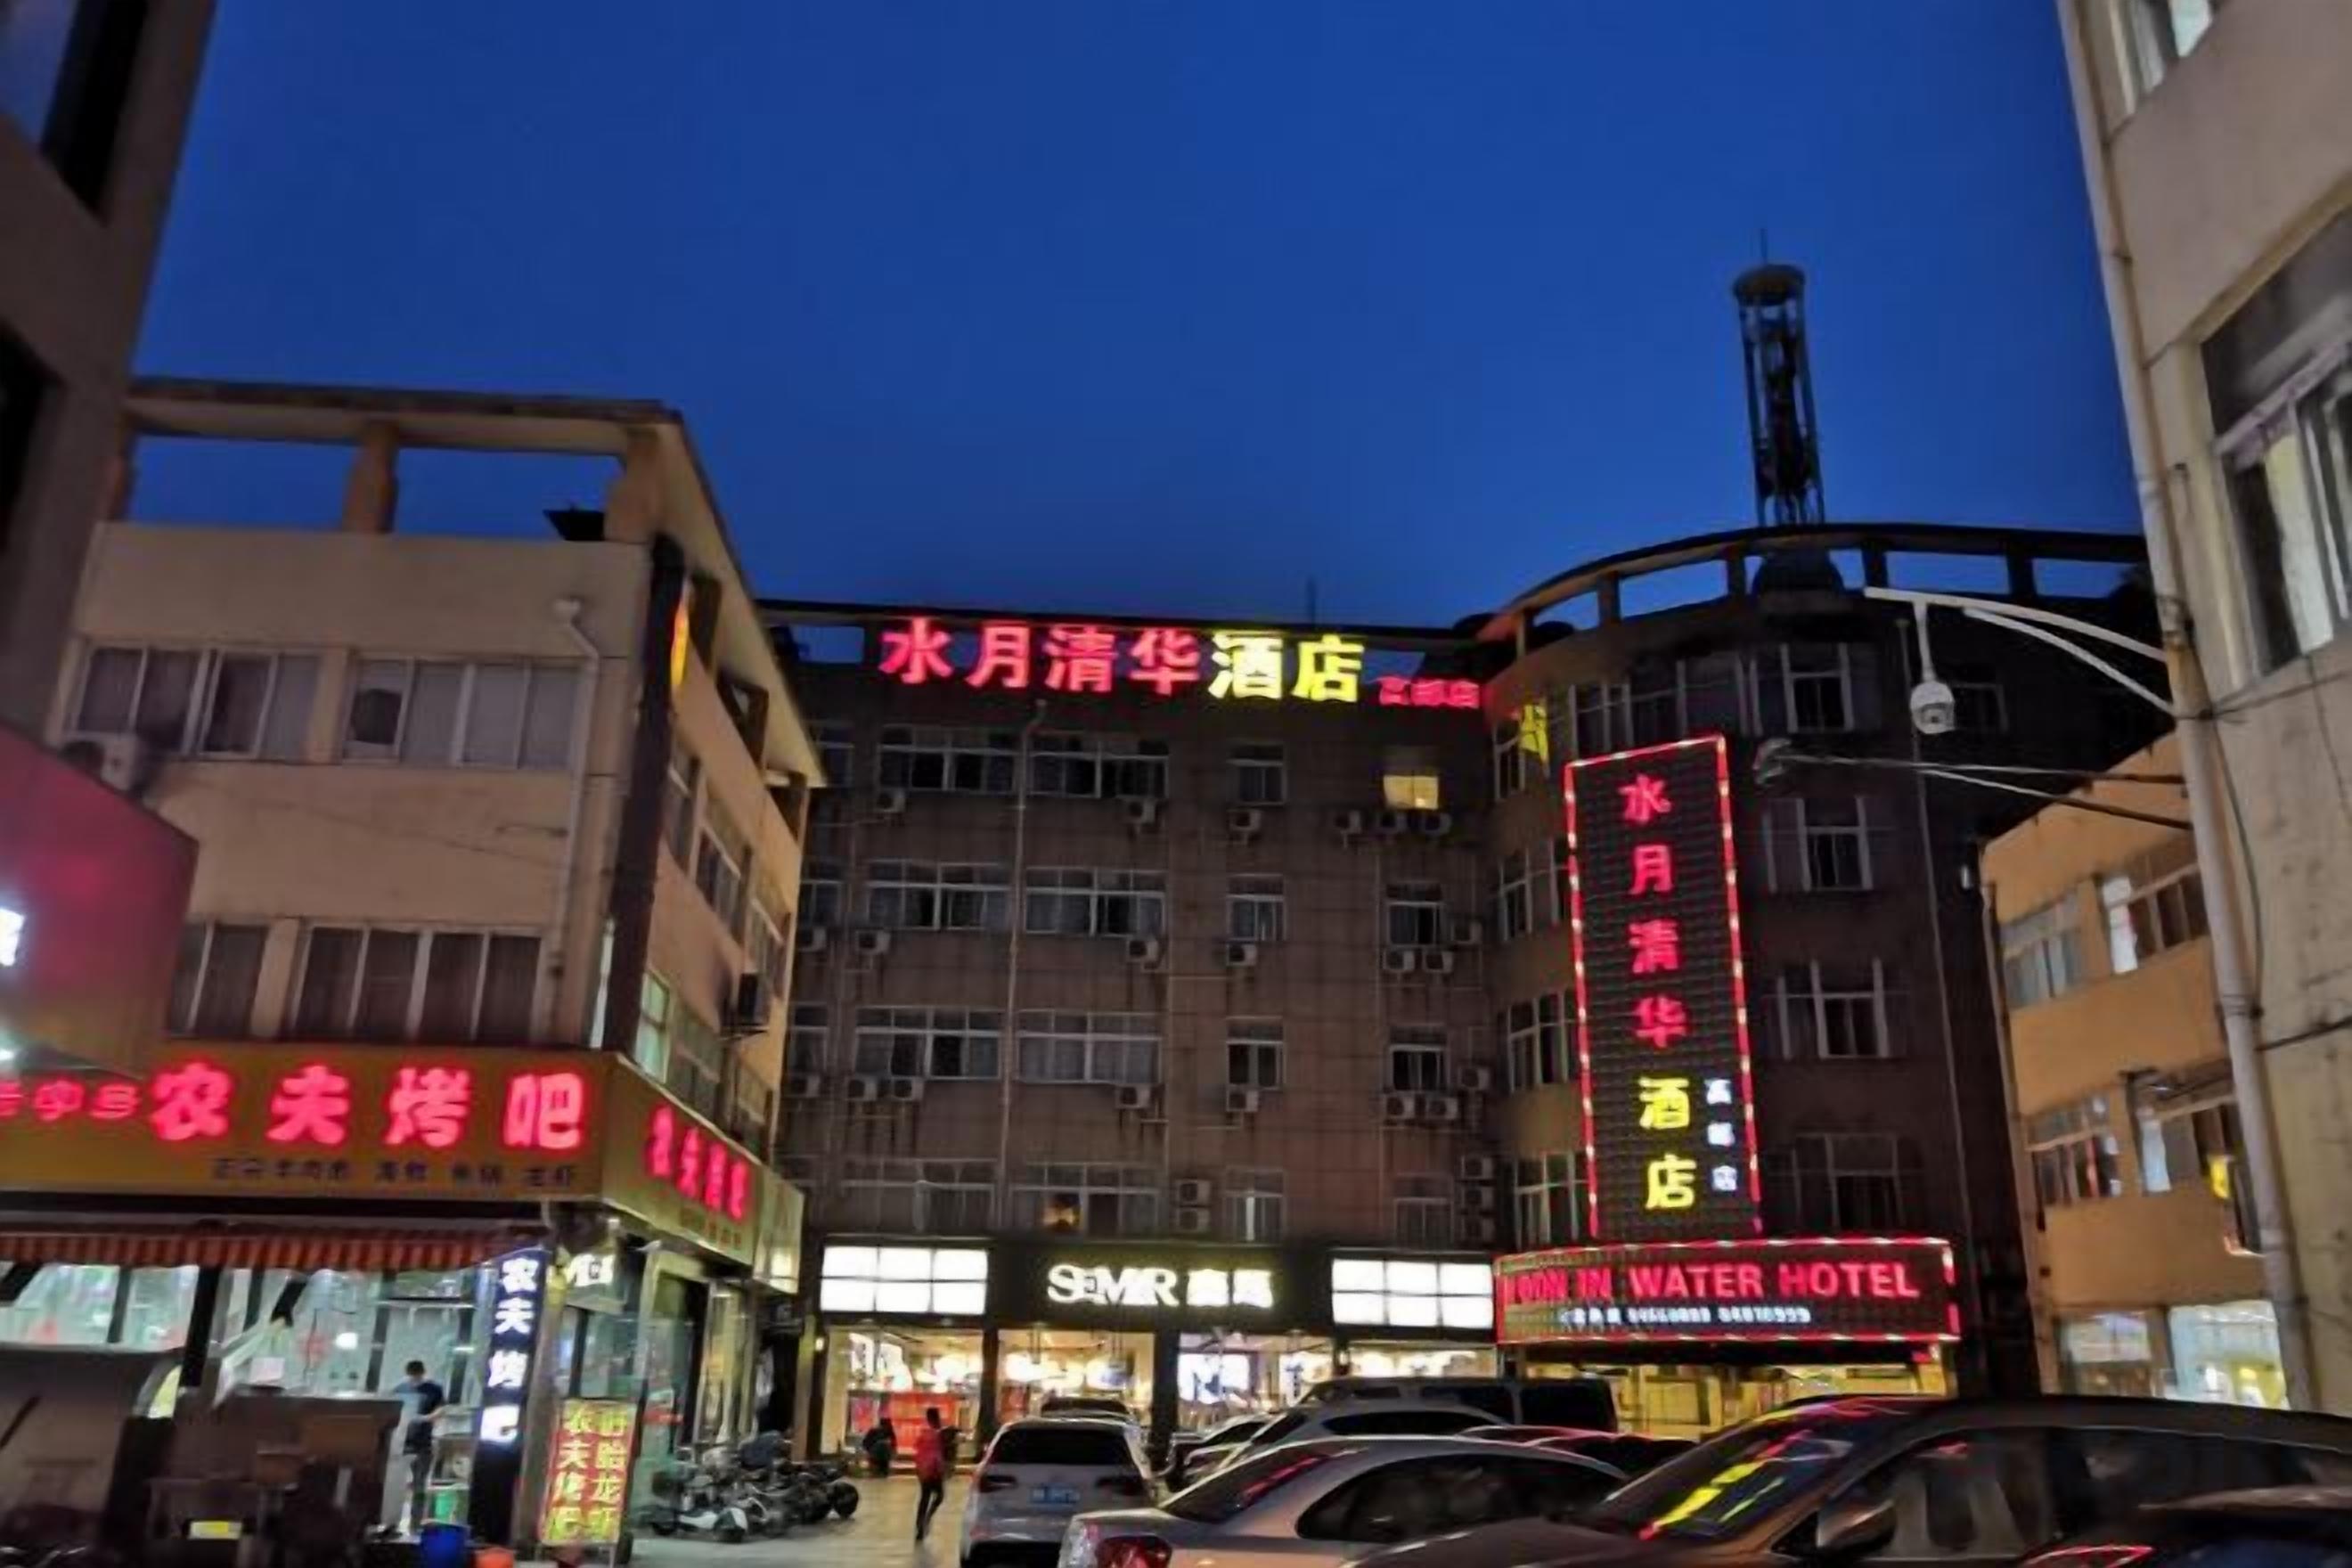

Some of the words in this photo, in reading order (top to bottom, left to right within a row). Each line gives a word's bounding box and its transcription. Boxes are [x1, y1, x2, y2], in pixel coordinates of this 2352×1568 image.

[878, 617, 1366, 703] 水月清华酒店
[1618, 773, 1697, 1213] 水月清华酒店
[150, 1060, 585, 1150] 农夫烤吧
[1628, 1262, 1763, 1299] WATER
[1777, 1262, 1921, 1297] HOTEL
